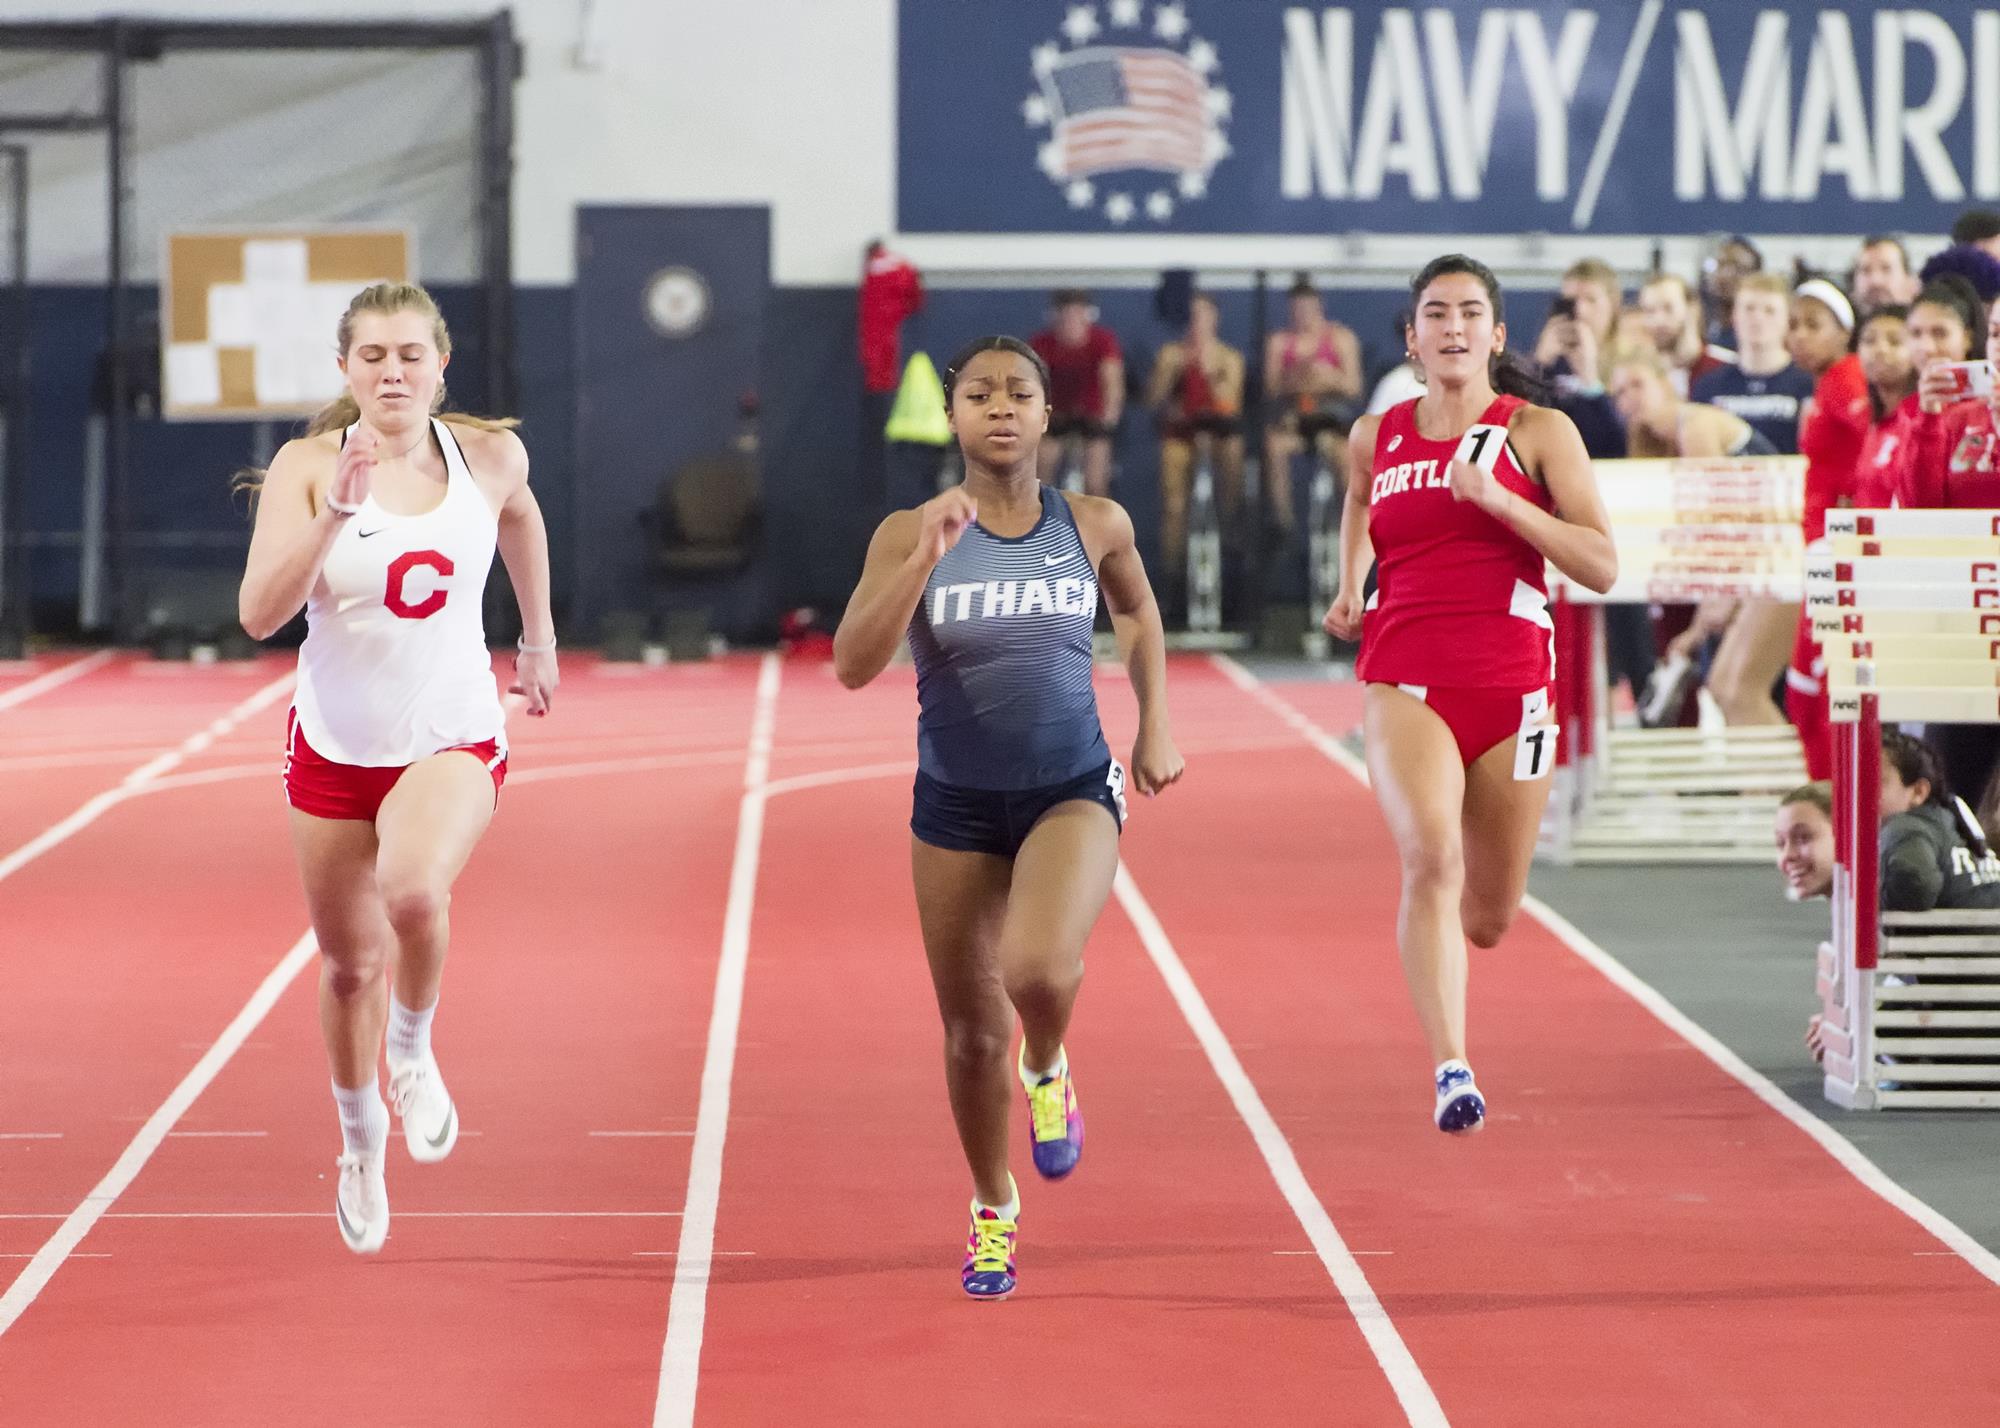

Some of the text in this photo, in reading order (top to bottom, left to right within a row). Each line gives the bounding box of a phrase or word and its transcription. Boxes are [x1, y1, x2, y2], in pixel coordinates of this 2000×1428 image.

[1469, 428, 1491, 463] 1
[384, 550, 454, 619] C
[932, 578, 1096, 625] ITHACA
[1526, 730, 1544, 775] 1
